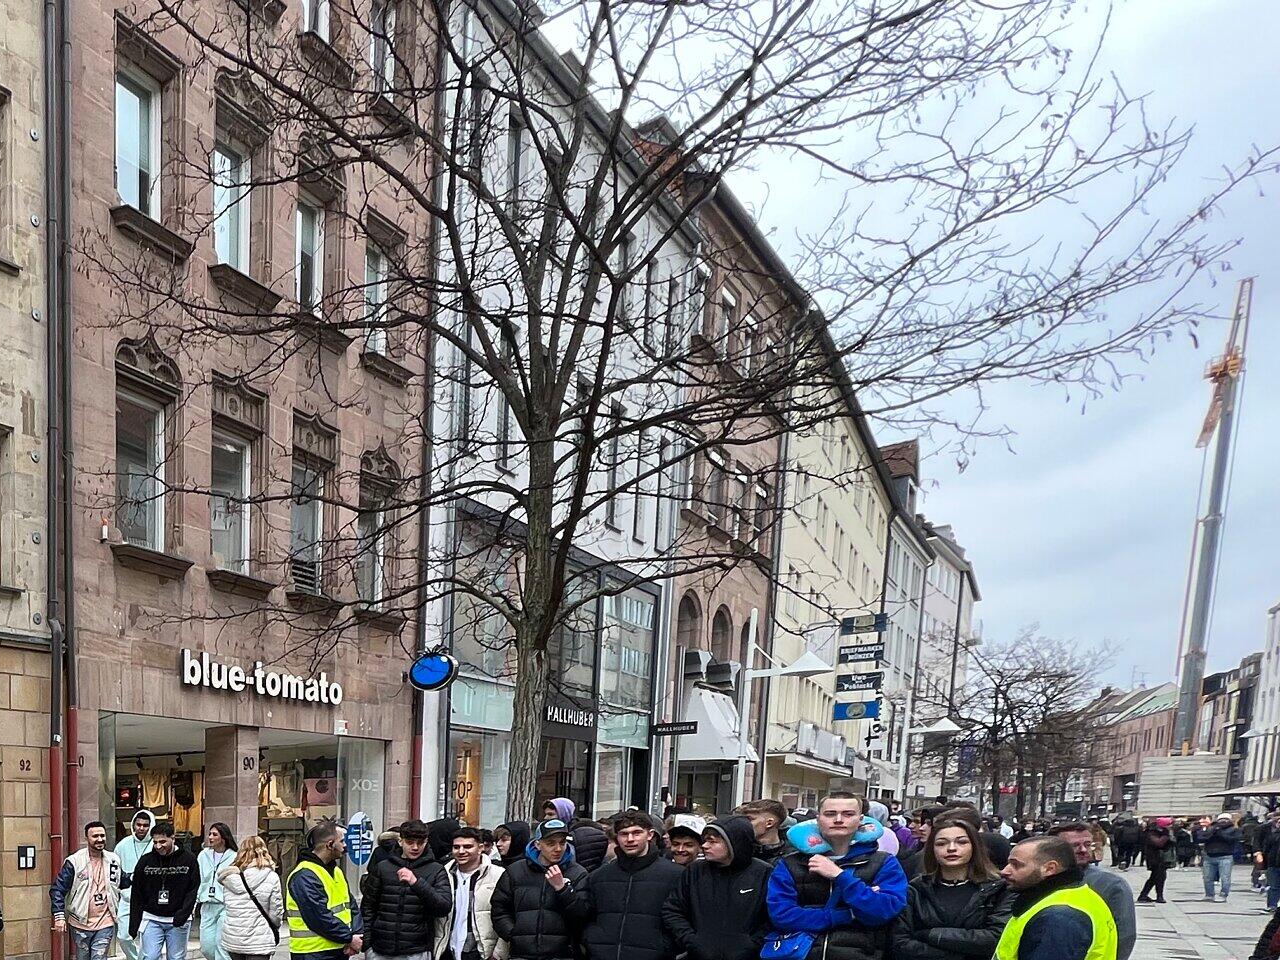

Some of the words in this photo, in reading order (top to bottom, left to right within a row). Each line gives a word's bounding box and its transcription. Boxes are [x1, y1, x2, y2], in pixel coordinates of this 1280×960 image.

[547, 705, 594, 728] HALLHUBER
[657, 725, 695, 733] HALLHUBER
[19, 758, 31, 771] 92
[243, 756, 255, 771] 90
[451, 780, 473, 799] POP
